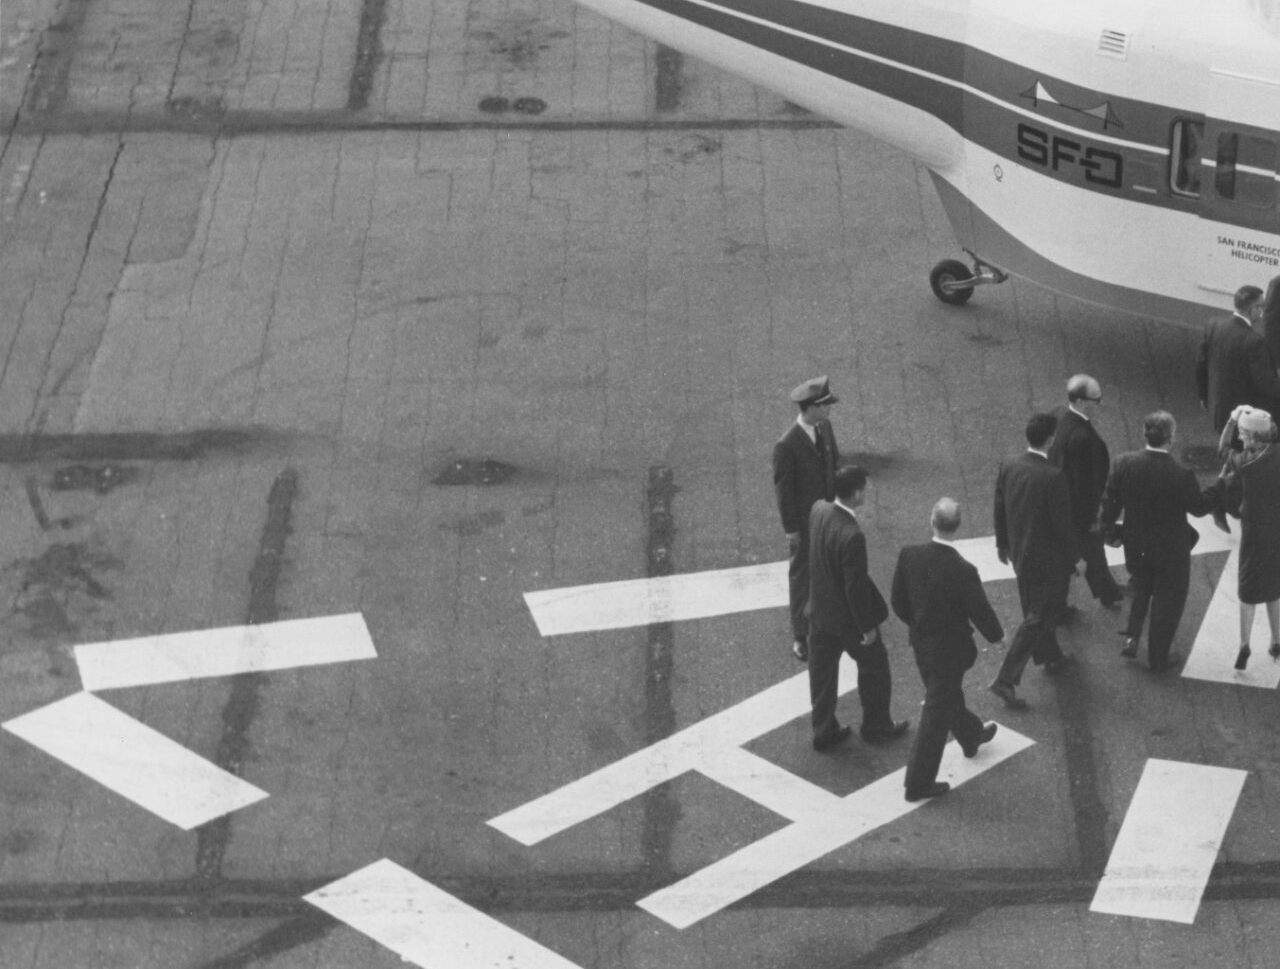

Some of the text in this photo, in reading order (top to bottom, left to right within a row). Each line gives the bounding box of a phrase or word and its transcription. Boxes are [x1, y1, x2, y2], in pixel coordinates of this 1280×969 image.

[1017, 122, 1124, 188] SFO
[1217, 235, 1235, 246] SAN
[1231, 249, 1279, 266] HELICOPTER
